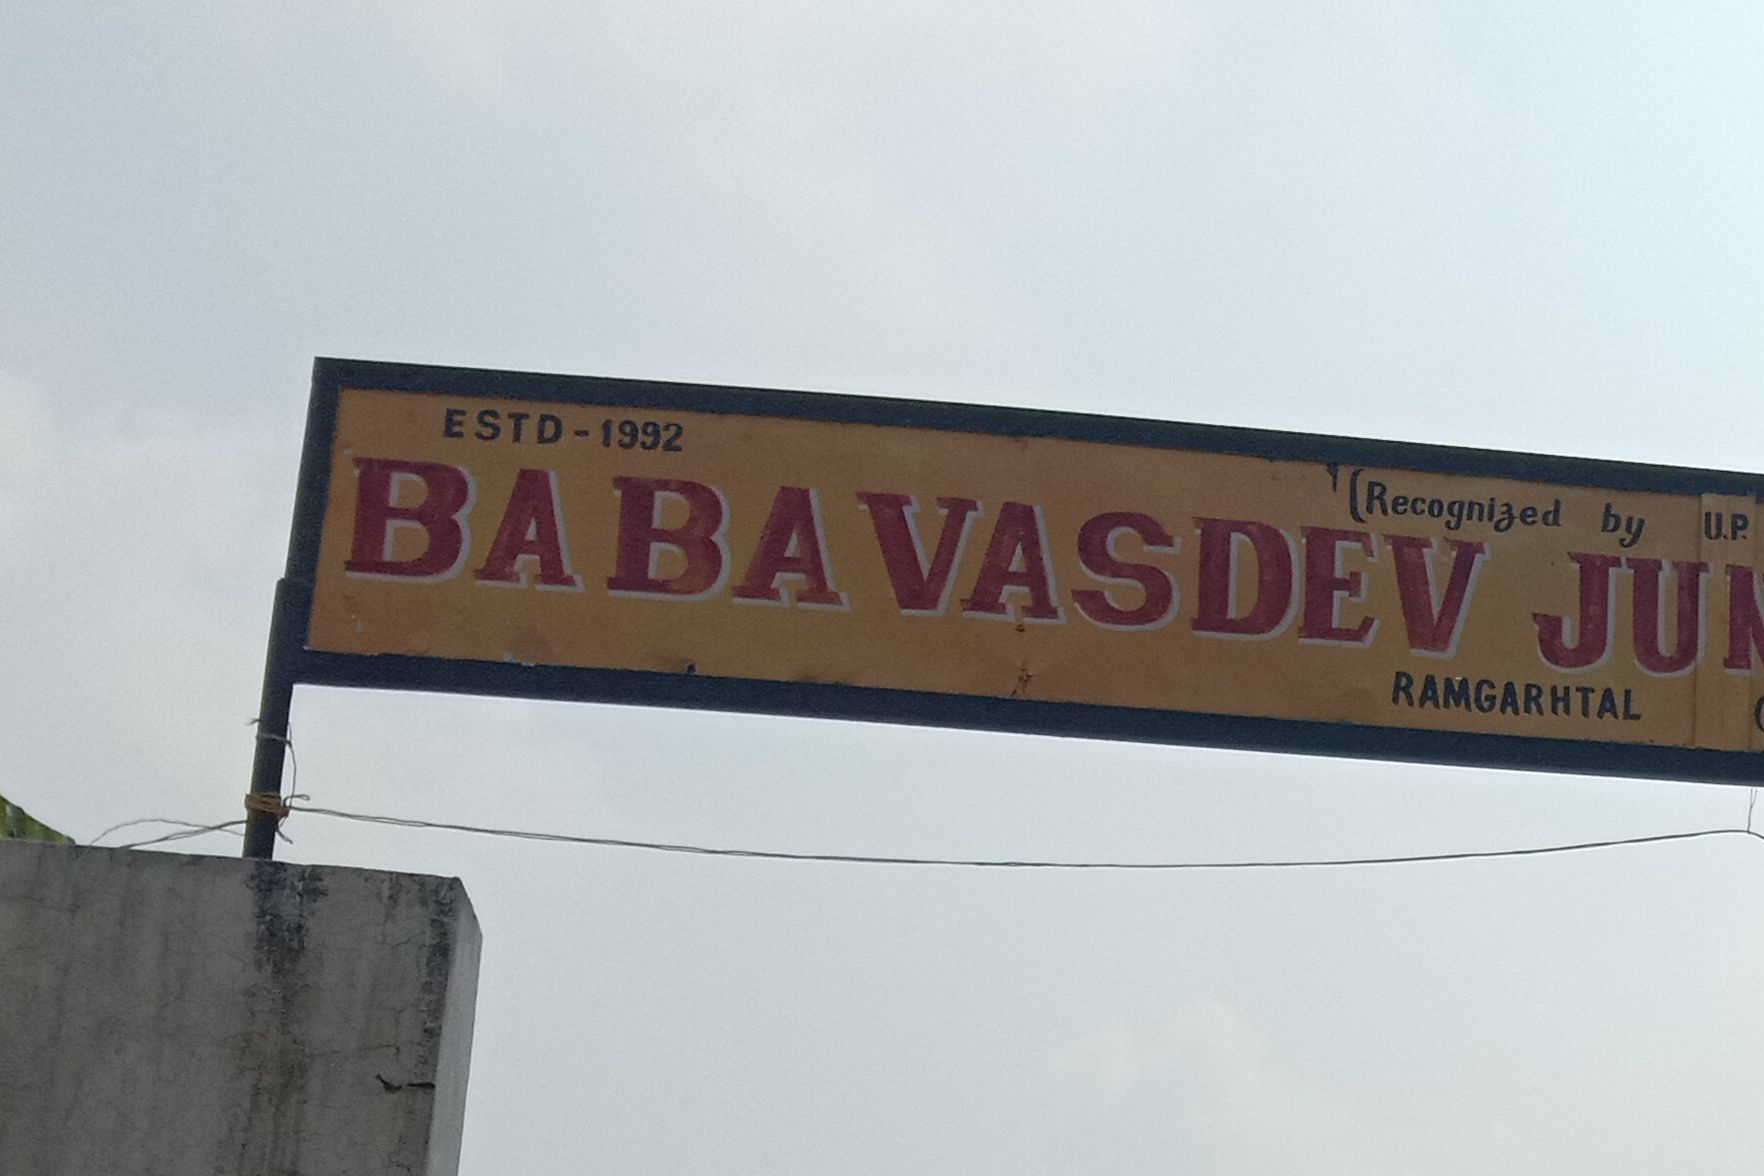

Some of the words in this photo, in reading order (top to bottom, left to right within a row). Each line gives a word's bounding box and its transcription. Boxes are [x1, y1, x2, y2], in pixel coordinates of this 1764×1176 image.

[1349, 468, 1561, 532] (Recognized
[1602, 502, 1645, 546] by
[1393, 671, 1641, 721] RAMGARHTAL
